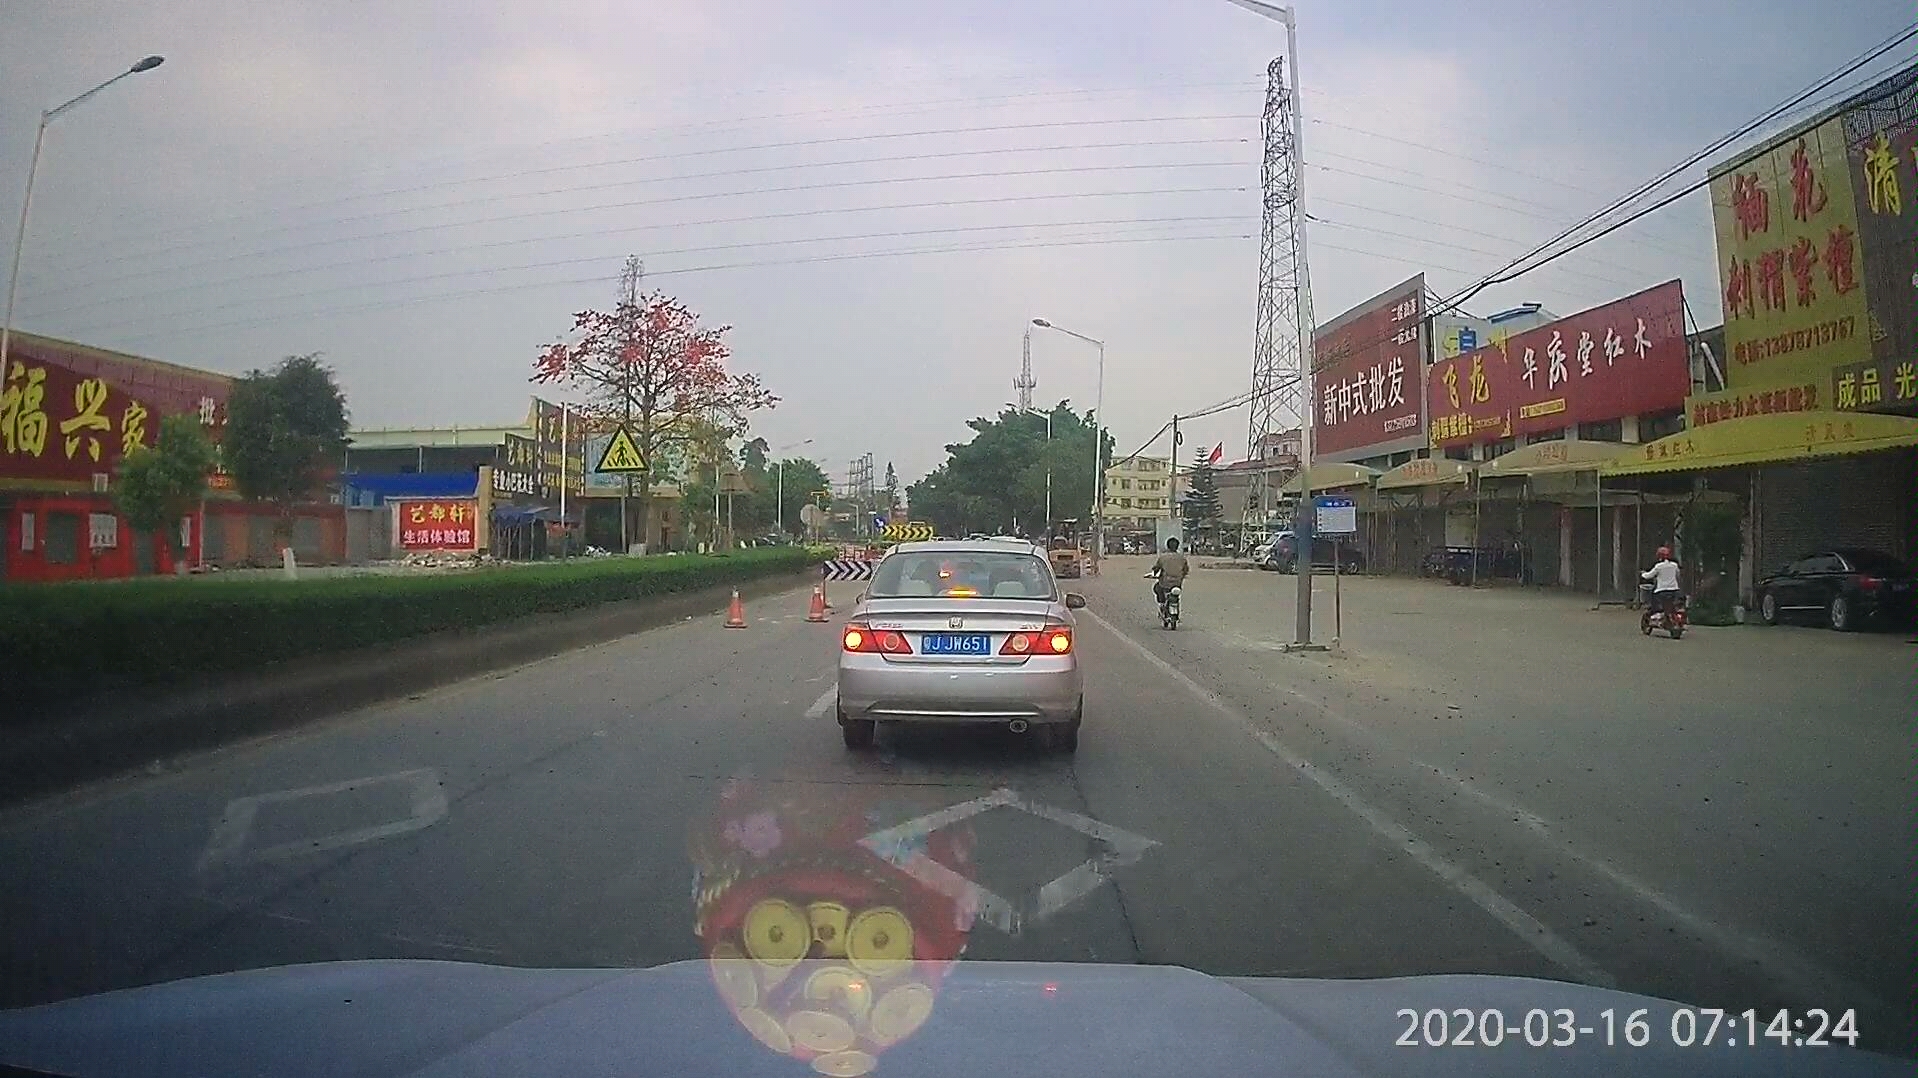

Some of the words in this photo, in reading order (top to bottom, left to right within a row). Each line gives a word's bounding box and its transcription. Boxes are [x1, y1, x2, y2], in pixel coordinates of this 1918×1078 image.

[1323, 356, 1405, 426] 新中式批发
[1838, 367, 1881, 410] 成品
[1895, 362, 1917, 400] 光
[403, 529, 471, 544] 生活体验馆
